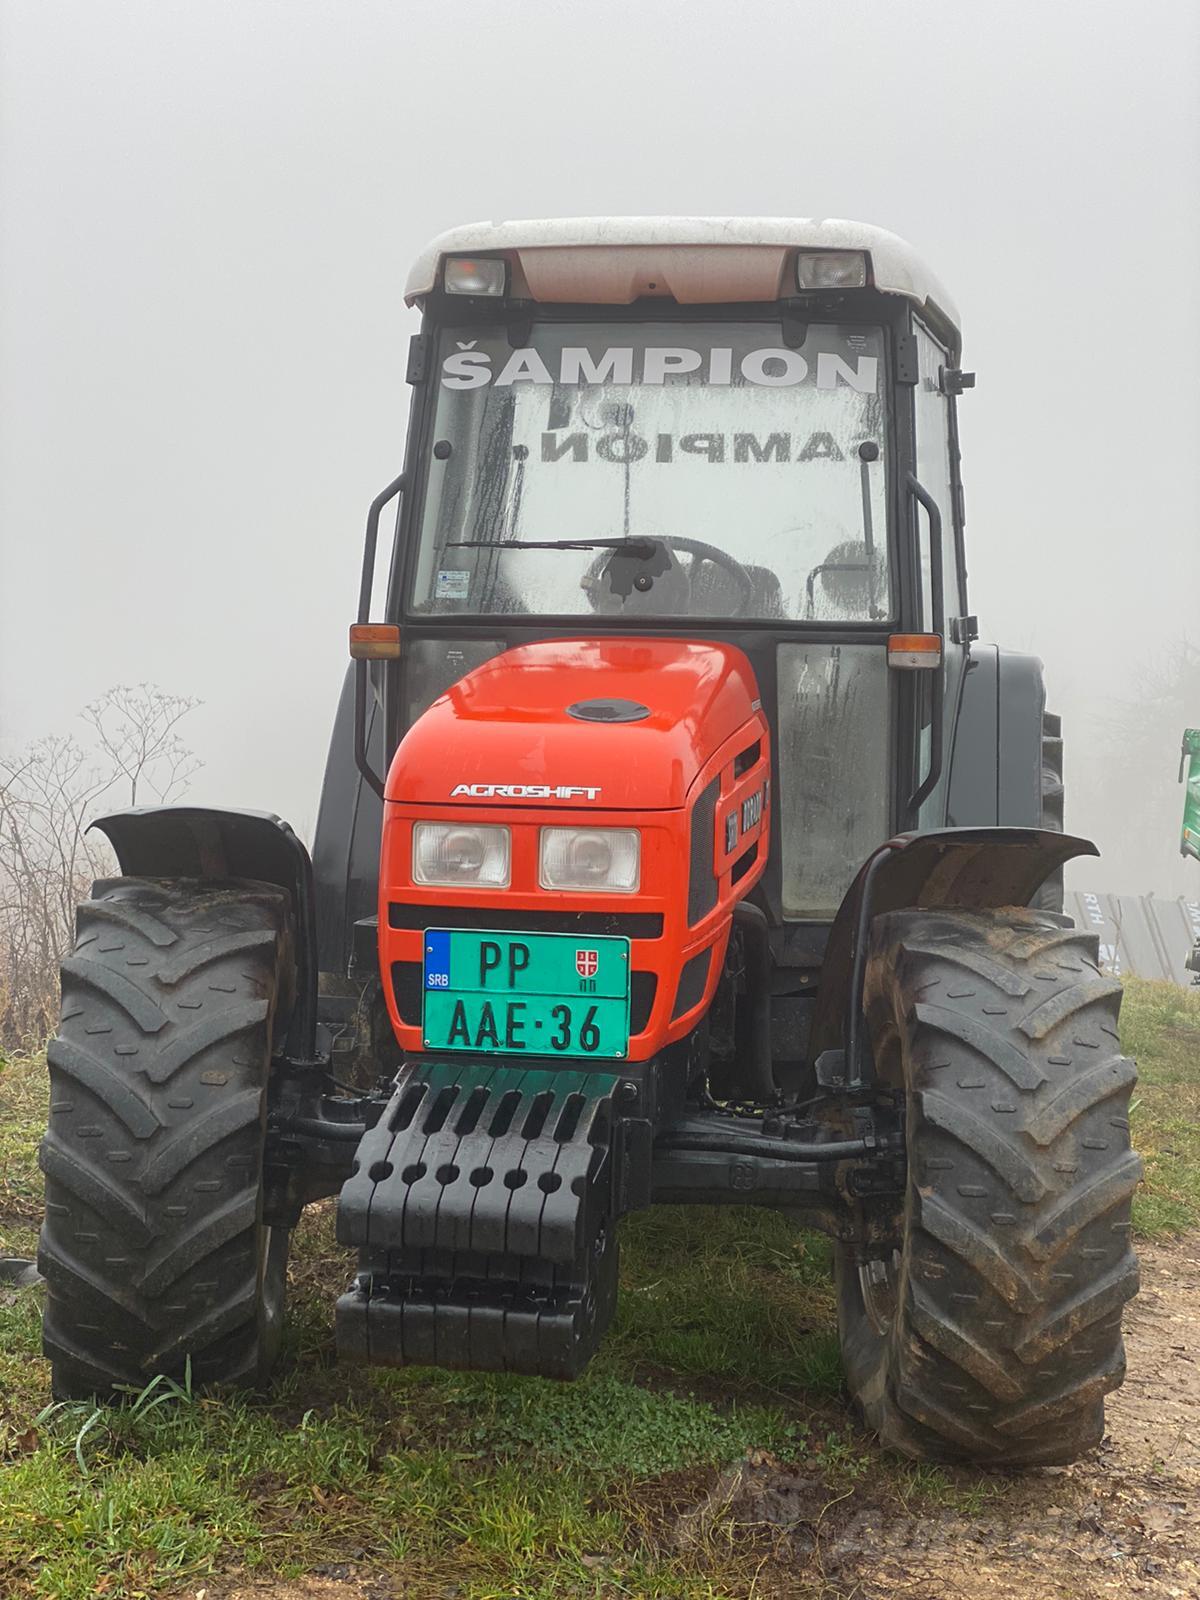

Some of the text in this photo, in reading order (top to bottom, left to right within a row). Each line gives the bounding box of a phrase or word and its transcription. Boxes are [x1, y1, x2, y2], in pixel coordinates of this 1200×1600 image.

[441, 340, 878, 394] ŠAMPION
[450, 784, 602, 800] AGROSHIFT
[428, 973, 449, 987] SRB
[480, 941, 530, 988] PP
